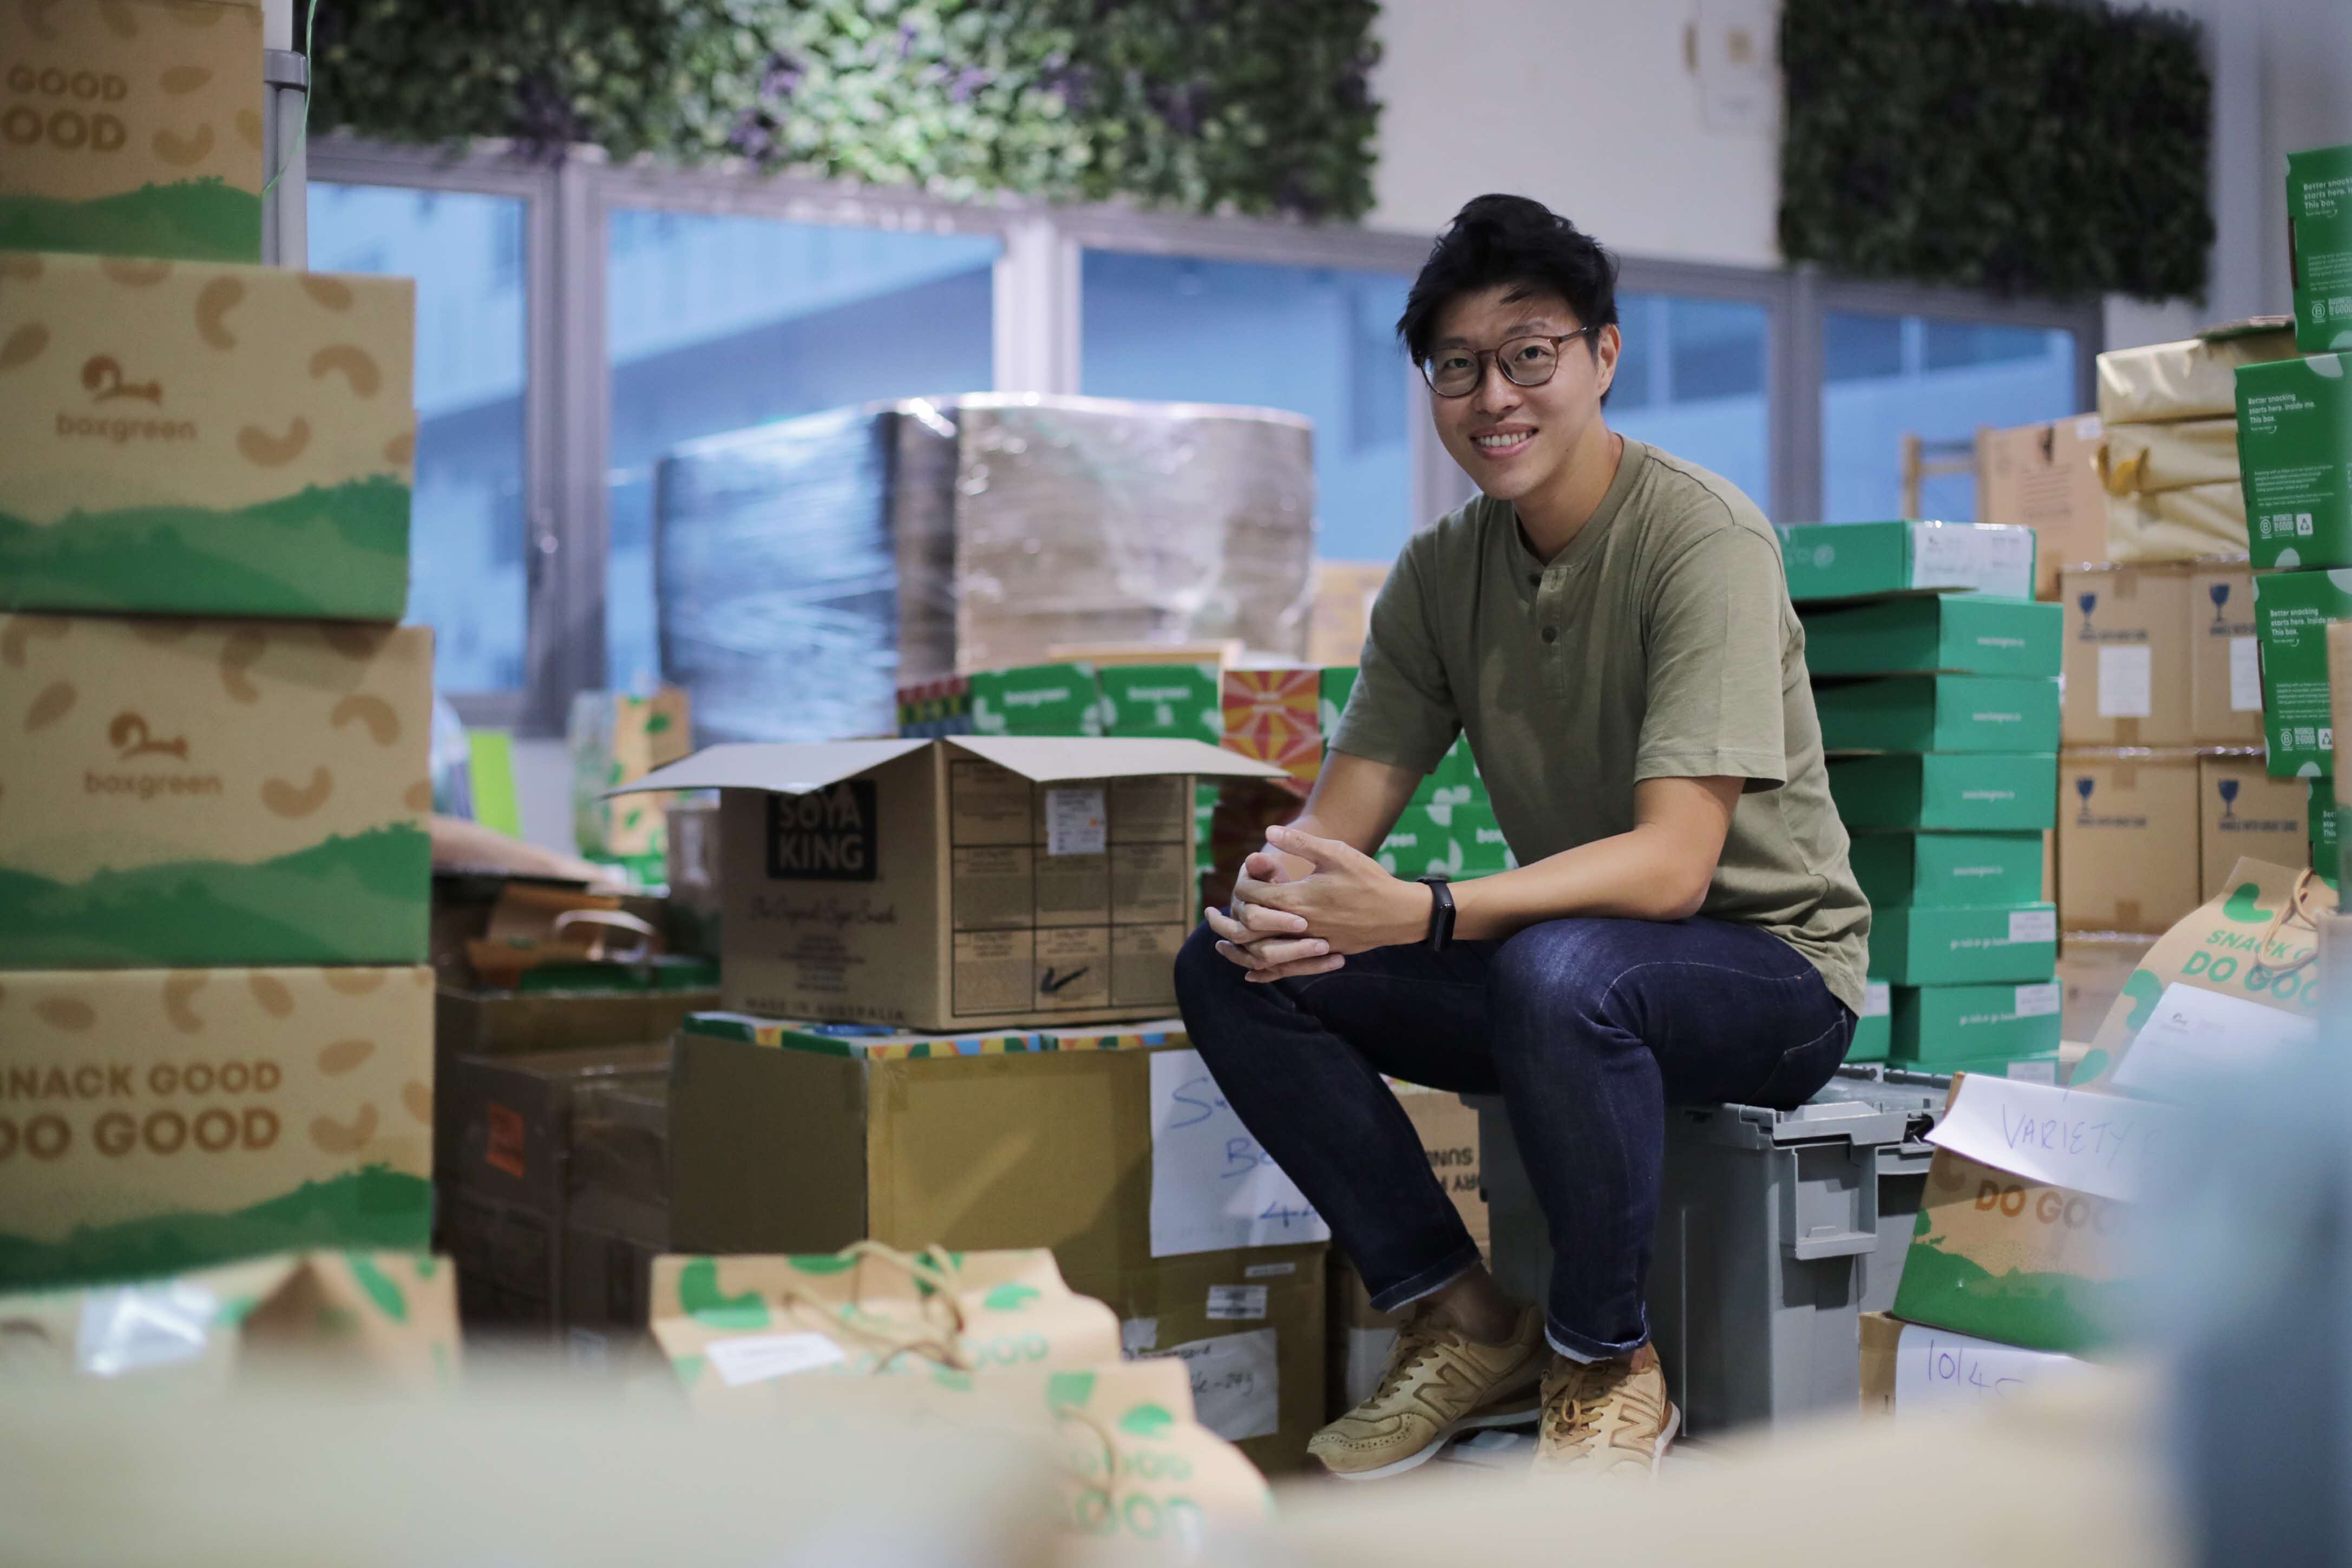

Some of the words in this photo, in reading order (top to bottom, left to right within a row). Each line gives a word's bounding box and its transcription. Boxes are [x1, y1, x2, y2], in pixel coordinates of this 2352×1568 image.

[7, 65, 128, 102] GOOD
[2304, 201, 2319, 209] This
[56, 414, 198, 444] boxgreen
[84, 770, 224, 800] boxgreen
[779, 782, 862, 828] SOYA
[778, 833, 864, 870] KING
[2181, 950, 2238, 983] DO
[0, 1063, 134, 1102] NACK
[147, 1059, 281, 1098] GOOD
[93, 1106, 281, 1158] GOOD
[2002, 1104, 2134, 1168] VARIETY
[1974, 1178, 2027, 1218] DO
